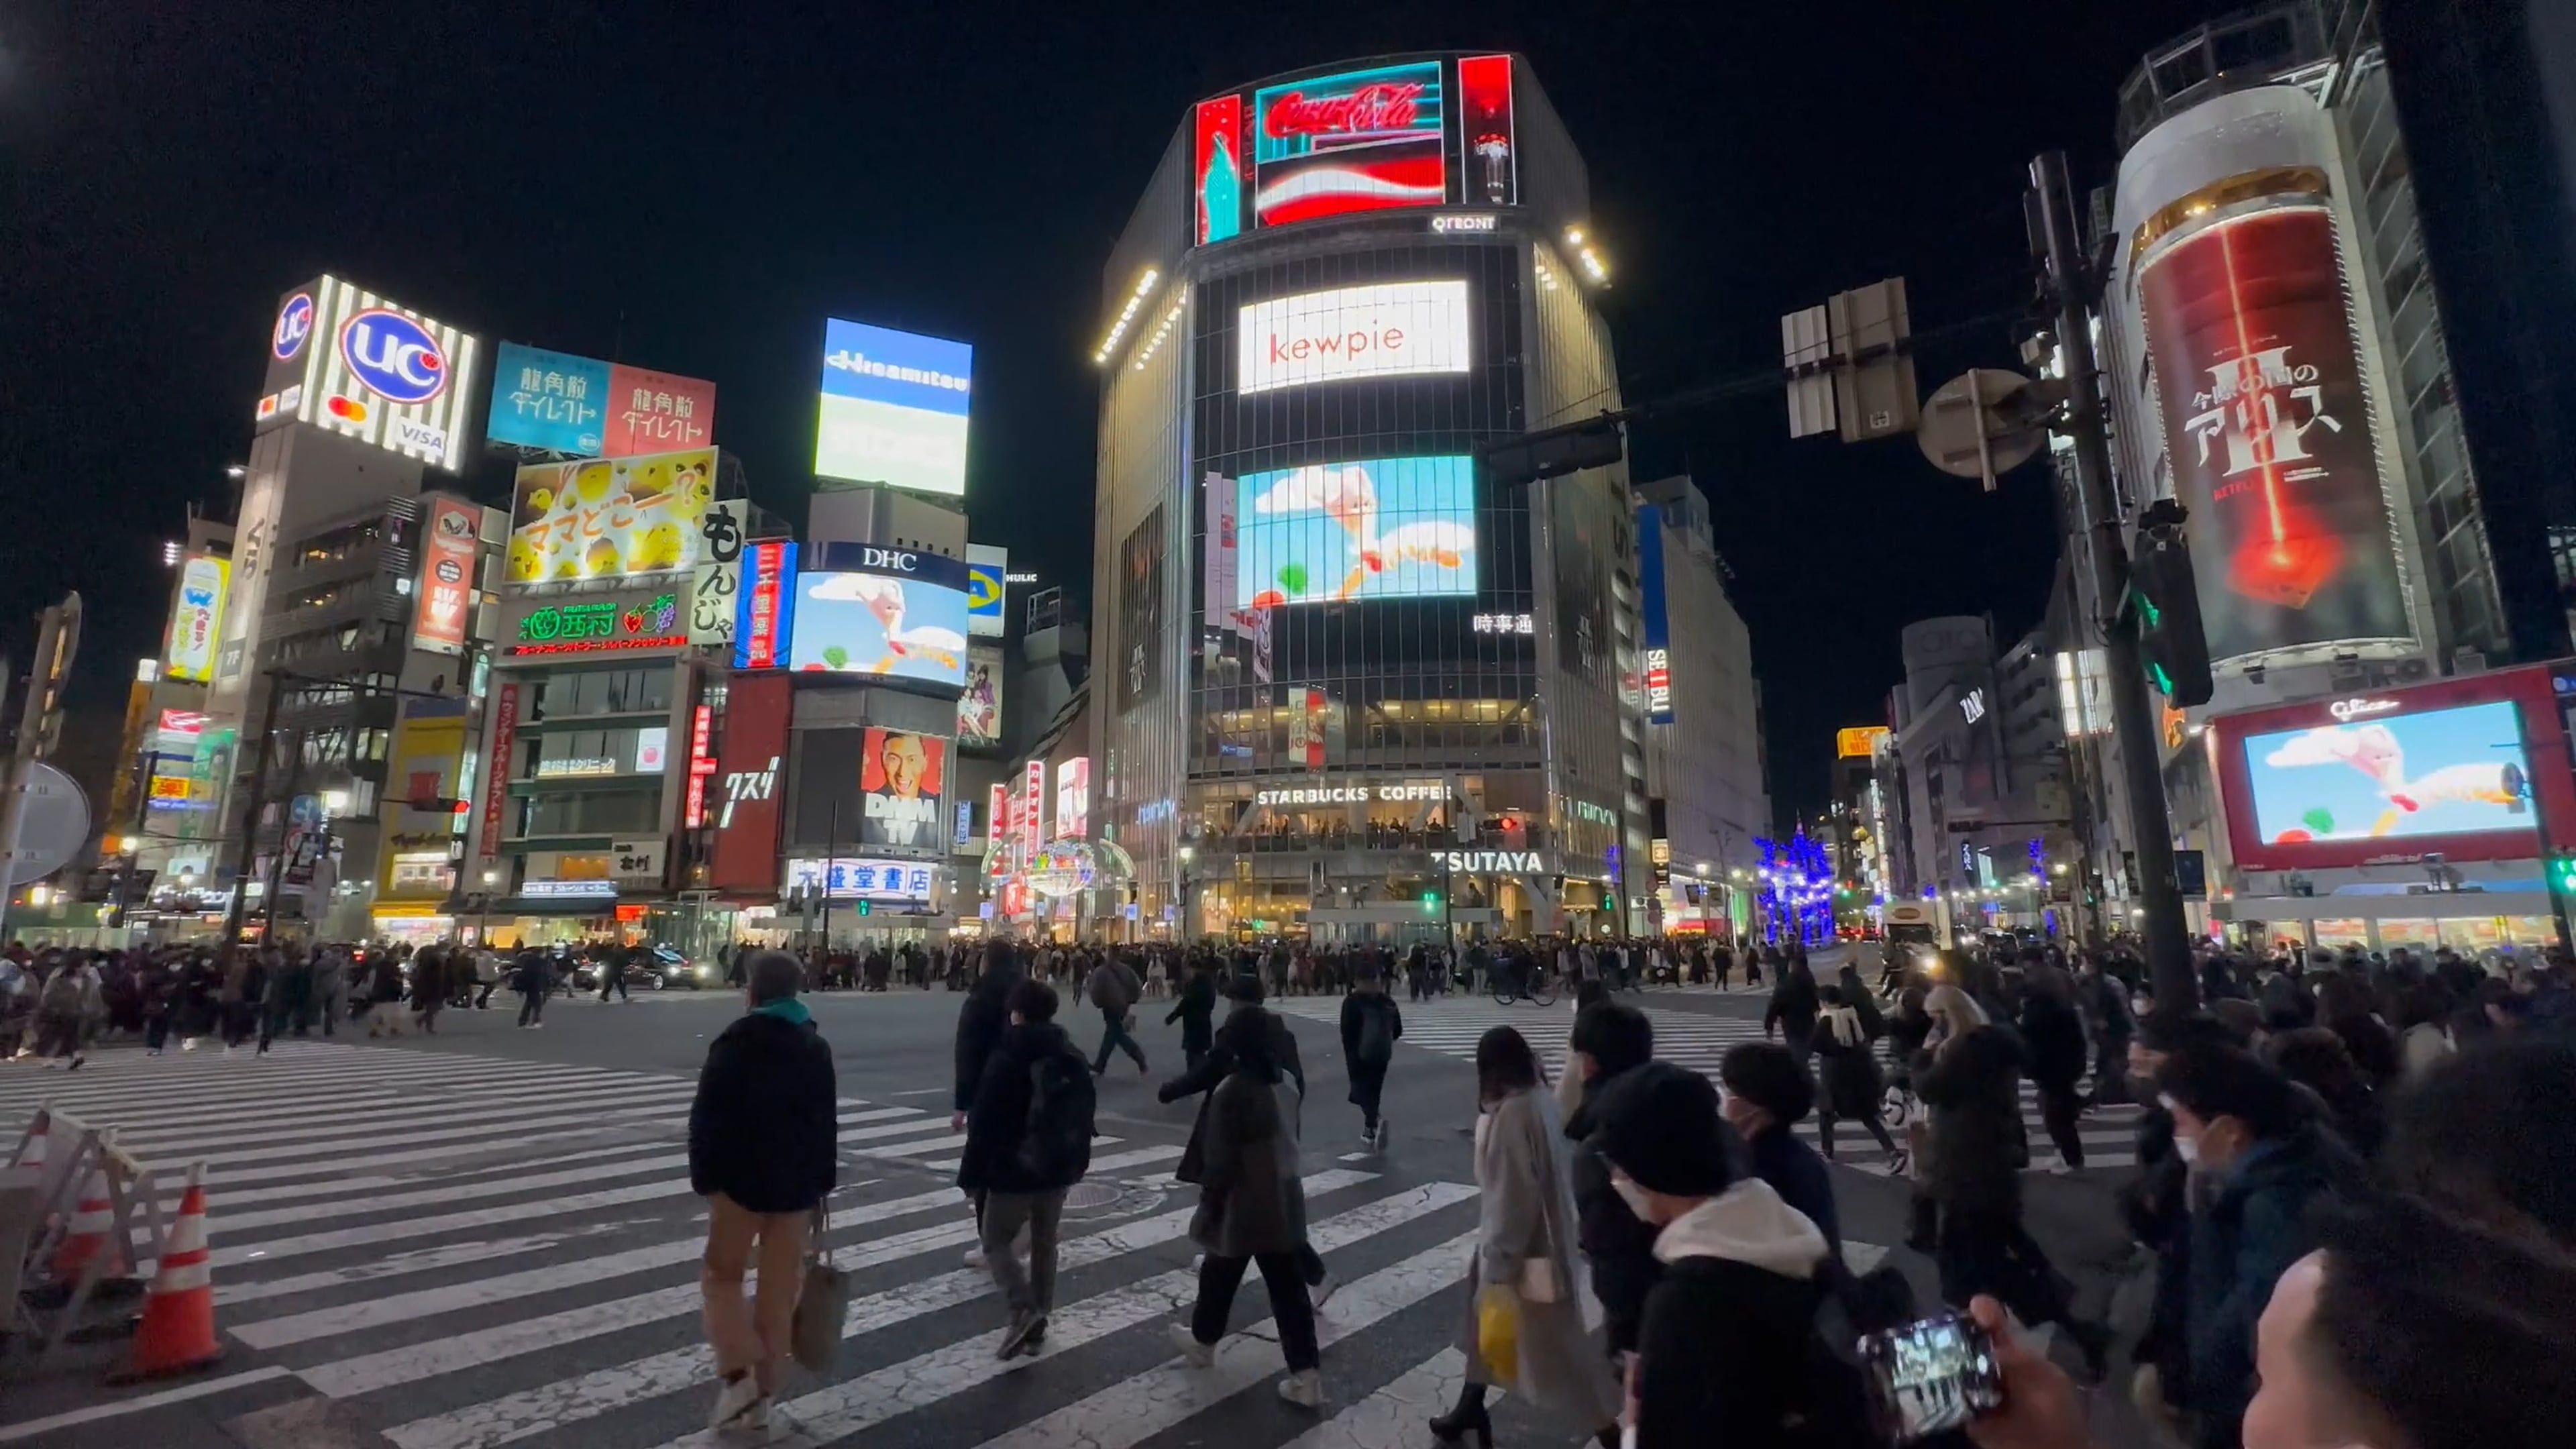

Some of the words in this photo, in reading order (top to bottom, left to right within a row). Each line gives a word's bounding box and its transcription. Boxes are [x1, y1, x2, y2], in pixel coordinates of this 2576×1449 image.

[278, 307, 310, 344] UC
[1270, 318, 1404, 364] kewpie
[354, 323, 439, 386] UC
[521, 367, 588, 399] 龍角散
[633, 388, 694, 419] 龍角散
[401, 425, 443, 451] VISA
[693, 504, 742, 640] もんじゃ
[863, 547, 917, 572] DHC
[1006, 574, 1038, 582] HULIC
[1648, 649, 1670, 712] SEIBU
[719, 756, 780, 829] クスリ
[865, 792, 936, 823] DMM
[1258, 787, 1368, 806] STARBUCKS
[883, 819, 918, 845] TV
